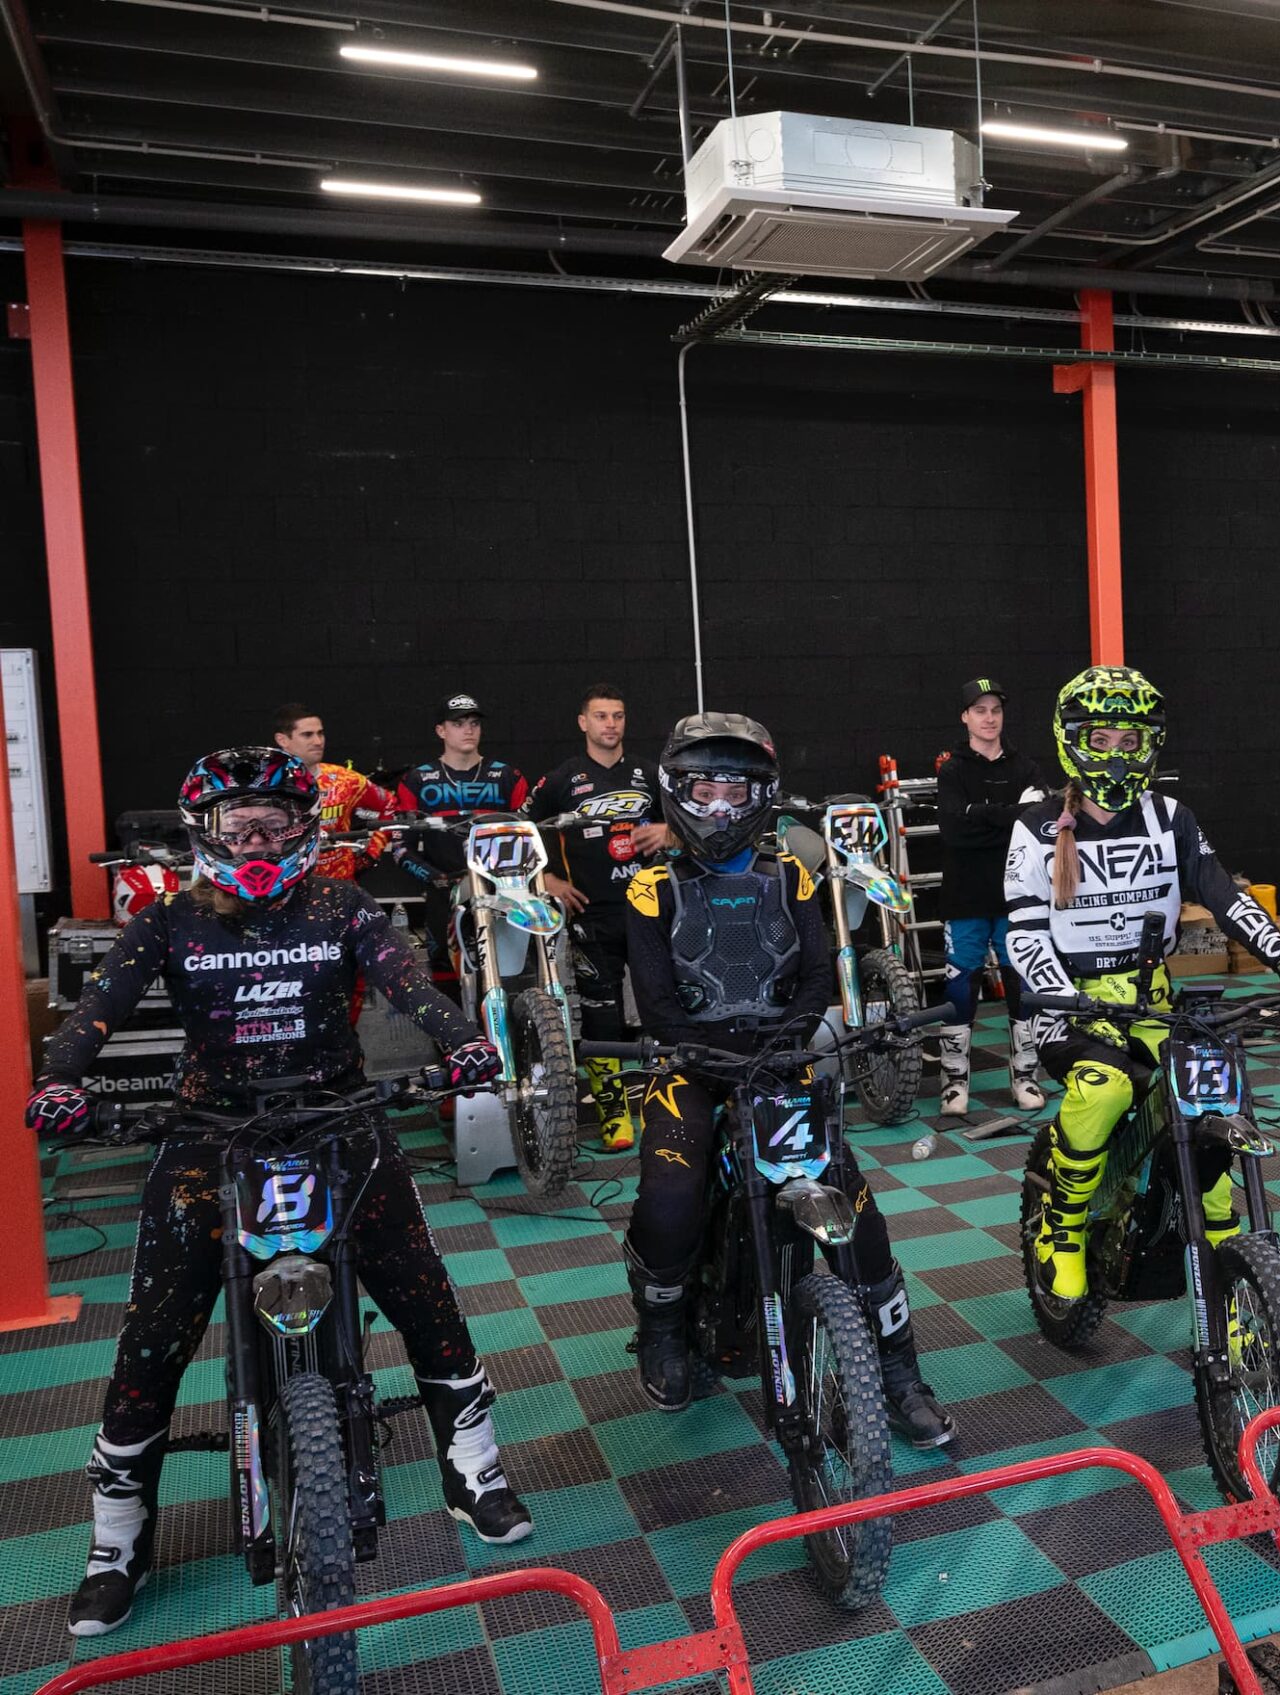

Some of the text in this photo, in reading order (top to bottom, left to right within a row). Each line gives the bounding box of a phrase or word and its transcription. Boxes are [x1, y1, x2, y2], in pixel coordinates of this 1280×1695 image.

[1044, 844, 1178, 888] NEAL
[1112, 887, 1161, 905] COMPANY
[183, 941, 342, 972] cannondale
[1096, 957, 1117, 969] DRT
[234, 980, 304, 1003] LAZER
[235, 1030, 306, 1044] SUSPENSIONS
[1185, 1060, 1231, 1096] 13
[768, 1109, 814, 1151] 4
[256, 1174, 316, 1224] 8
[771, 1349, 785, 1404] DUNLOP
[239, 1472, 251, 1537] DUNLOP
